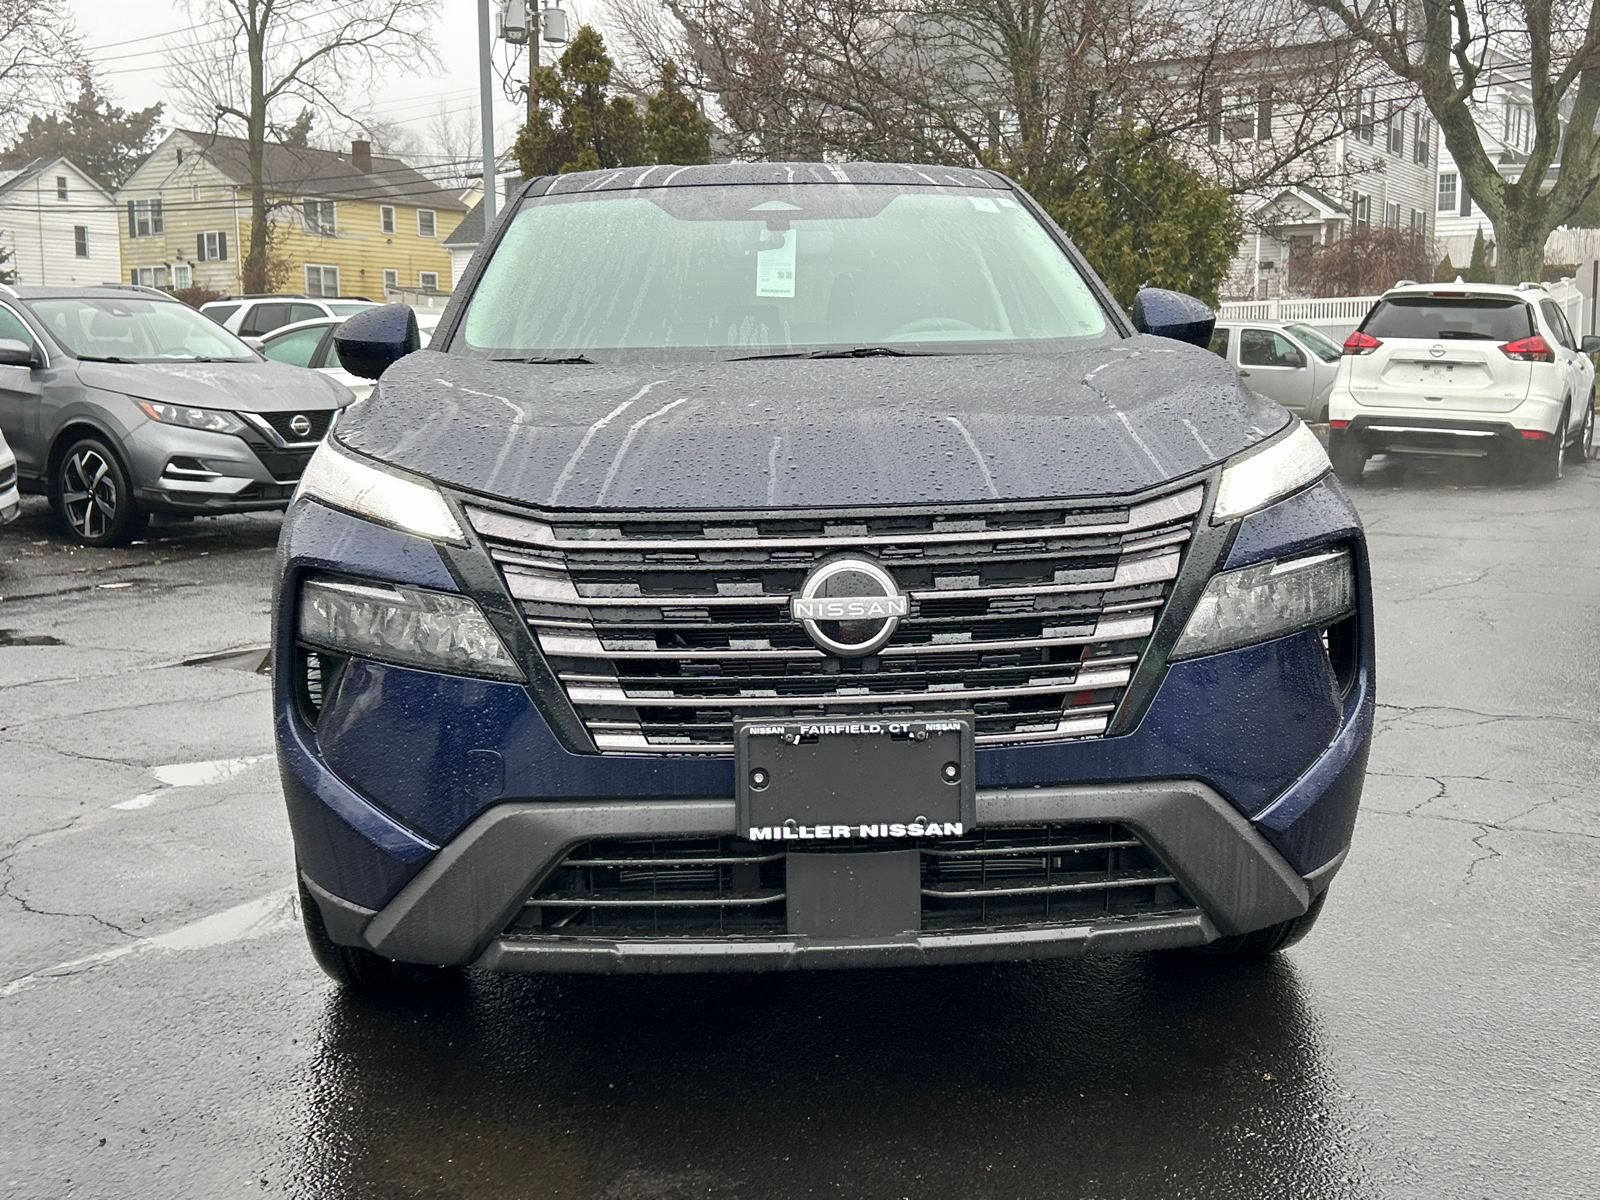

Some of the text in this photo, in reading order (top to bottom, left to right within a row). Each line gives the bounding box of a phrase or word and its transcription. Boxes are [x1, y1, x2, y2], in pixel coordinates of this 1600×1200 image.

[796, 600, 904, 616] NISSAN
[749, 726, 785, 735] NISSAN
[800, 723, 910, 735] FAIRFIELD, CT
[925, 722, 961, 731] NISSAN
[749, 822, 963, 841] MILLER NISSAN
